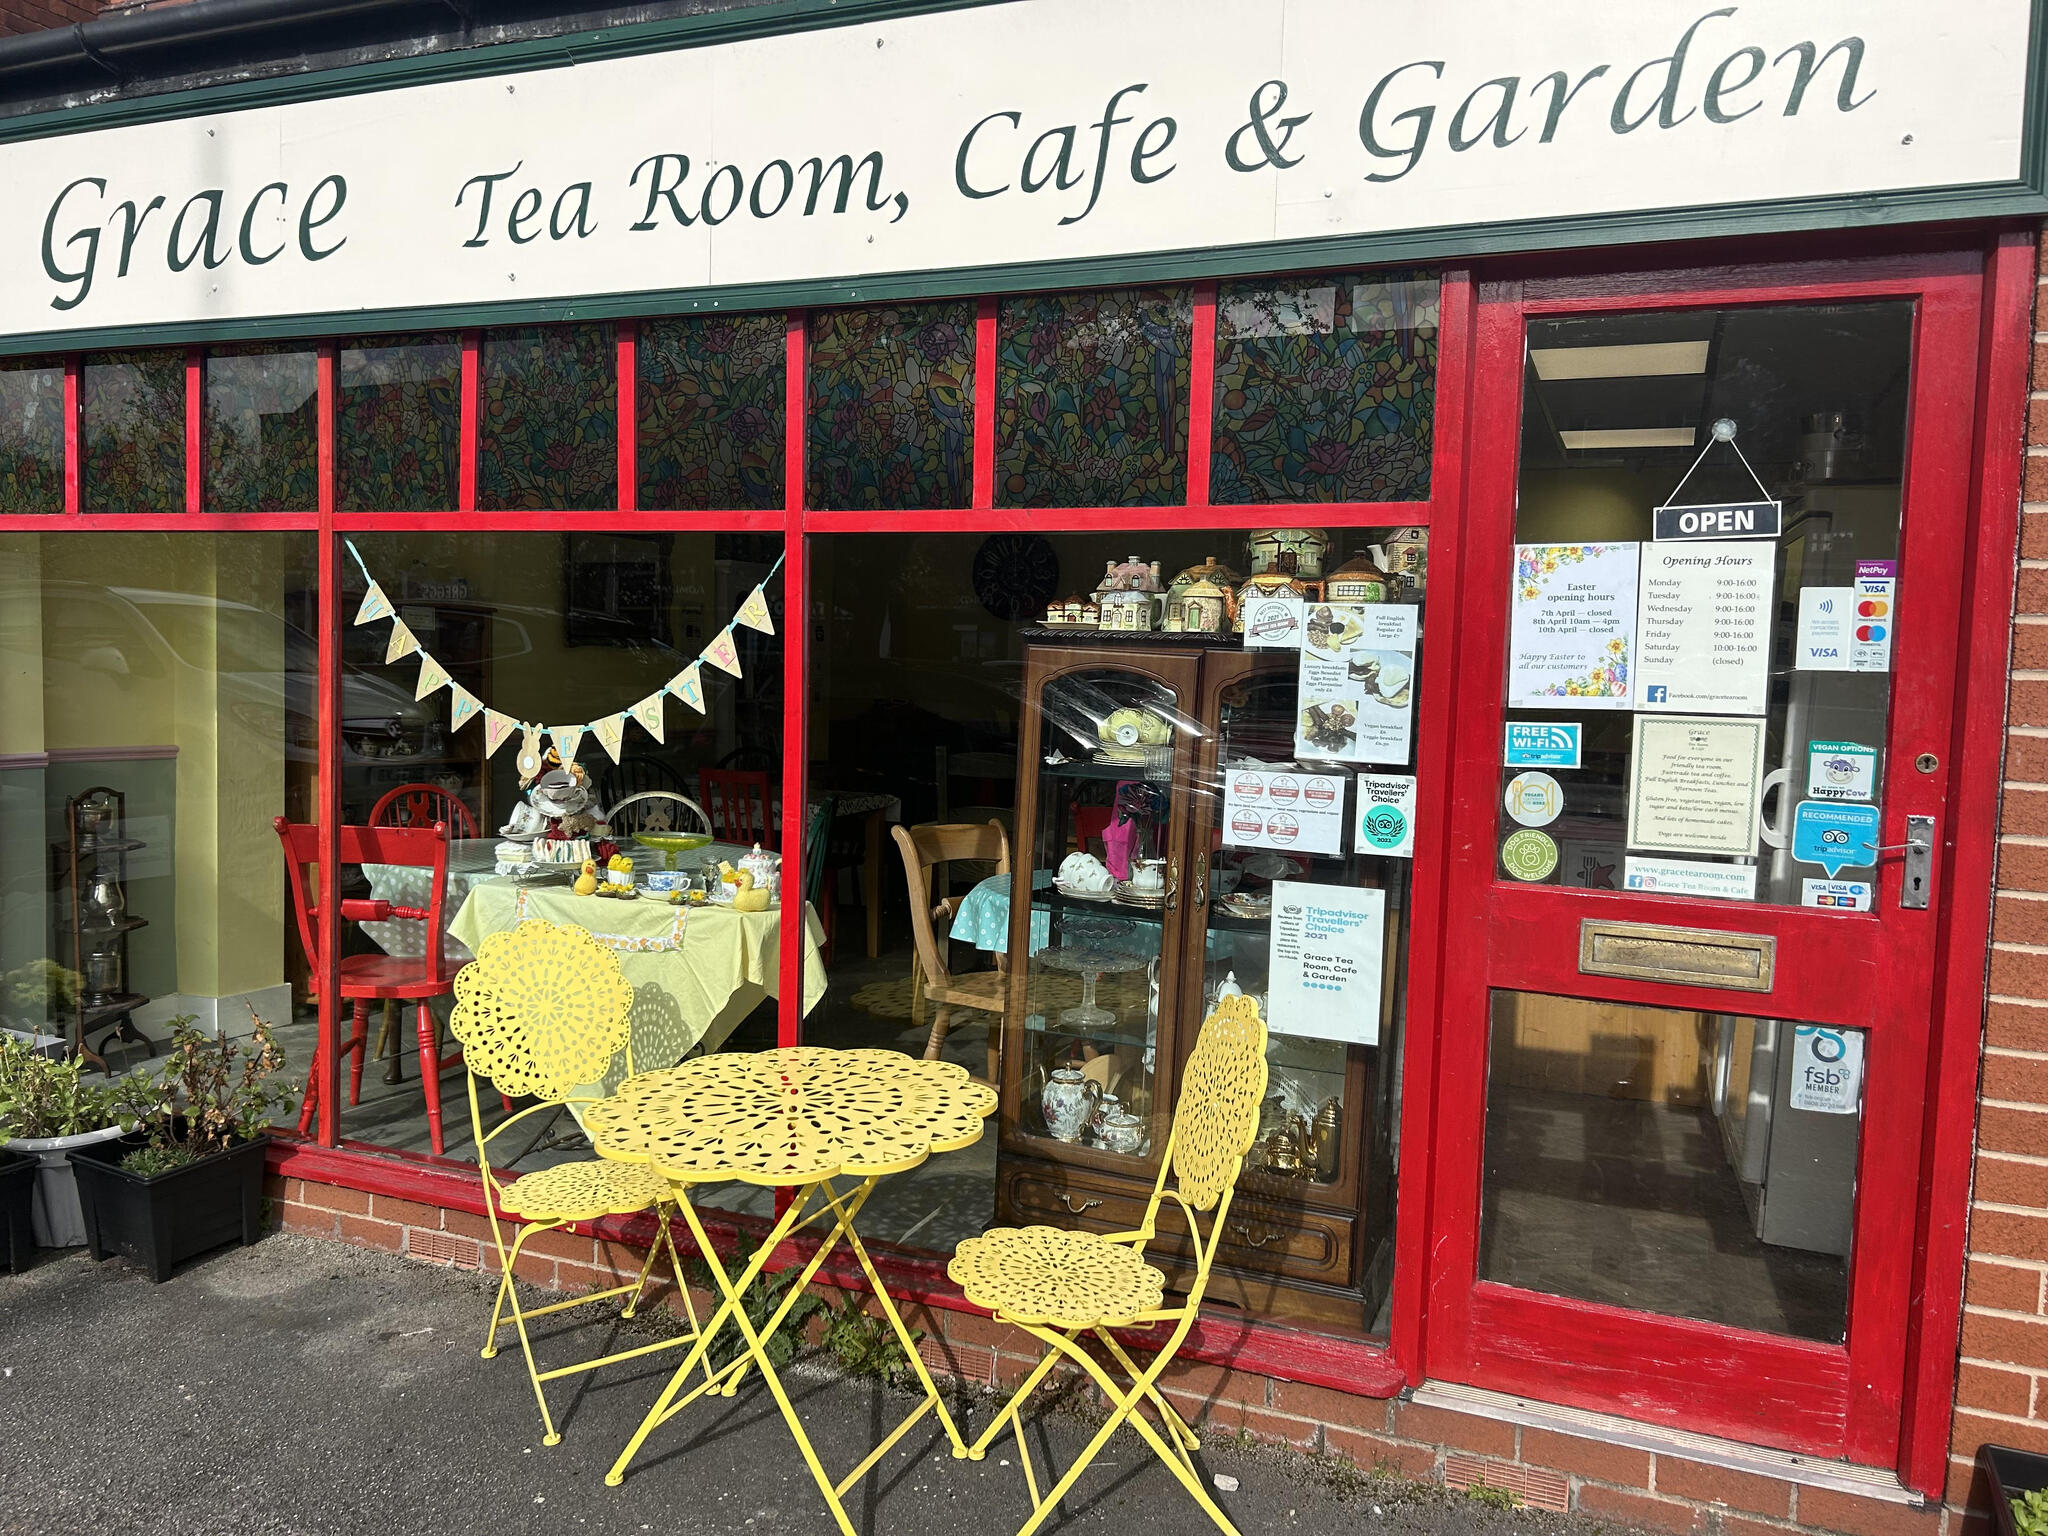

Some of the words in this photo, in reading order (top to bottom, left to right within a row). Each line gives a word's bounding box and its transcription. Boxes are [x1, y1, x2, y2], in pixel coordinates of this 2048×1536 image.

[40, 173, 348, 311] Grace
[454, 159, 598, 248] Tea
[629, 150, 910, 232] Room,
[954, 82, 1178, 226] Cafe
[1224, 79, 1313, 173] &
[1357, 6, 1878, 183] Garden
[1679, 509, 1754, 534] OPEN
[1662, 555, 1712, 569] Opening
[1714, 555, 1753, 566] Hours
[1858, 566, 1889, 576] NetPay
[1567, 583, 1597, 591] Easter
[1648, 579, 1682, 589] Monday
[1716, 579, 1757, 587] 9:00-16:00
[1863, 585, 1887, 593] VISA
[1547, 592, 1585, 602] opening
[1587, 592, 1615, 601] hours
[1647, 592, 1681, 601] Tuesday
[1715, 592, 1756, 600] 9:00-16:00
[1541, 609, 1554, 617] 7th
[1556, 609, 1576, 618] April
[1587, 609, 1612, 617] closed
[1646, 604, 1693, 614] Wednesday
[1714, 605, 1756, 613] 9:00-16:00
[1548, 618, 1567, 626] April
[1602, 618, 1620, 626] 4pm
[1645, 617, 1684, 627] Thursday
[1713, 618, 1755, 626] 9:00-16:00
[1538, 626, 1556, 634] 10th
[1557, 626, 1577, 635] April
[1588, 626, 1614, 634] closed
[1645, 630, 1671, 640] Friday
[1713, 631, 1754, 639] 9:00-16:00
[1644, 643, 1681, 652] Saturday
[1712, 644, 1758, 653] 10:00-16:00
[1808, 647, 1839, 658] VISA
[1518, 653, 1547, 663] Happy
[1549, 652, 1576, 661] Easter
[1643, 656, 1674, 666] Sunday
[1712, 657, 1744, 666] (closed)
[360, 593, 507, 743] HAPPY
[1518, 662, 1530, 670] all
[559, 600, 767, 759] EASTER
[1513, 726, 1549, 737] FREE
[1688, 728, 1711, 736] Grace
[1512, 737, 1549, 748] WI-FI
[1812, 743, 1839, 752] VEGAN
[1840, 744, 1874, 754] OPTIONS
[1364, 780, 1411, 791] Tripadvisor
[1365, 787, 1408, 798] Travellers'
[1812, 786, 1868, 798] HappyCow
[1371, 794, 1400, 805] Choice
[1801, 811, 1874, 824] RECOMMENDED
[1506, 836, 1520, 851] DOG
[1519, 832, 1553, 848] FRIENDLY
[1814, 845, 1857, 856] tripadvisor
[1508, 862, 1523, 876] DOG
[1523, 860, 1555, 879] WELCOME
[1634, 865, 1746, 882] www.gracetearoom.com
[1657, 880, 1681, 889] Grace
[1682, 882, 1696, 890] Tea
[1697, 884, 1721, 892] Room
[1722, 885, 1730, 893] &
[1730, 886, 1749, 895] Cafe
[1810, 883, 1827, 892] VISA
[1830, 884, 1848, 892] VISA
[1305, 906, 1369, 921] Tripadvisor
[1305, 914, 1363, 928] Travellers'
[1305, 922, 1345, 934] Choice
[1303, 931, 1328, 941] 2021
[1303, 952, 1333, 963] Grace
[1334, 956, 1354, 966] Tea
[1302, 961, 1332, 973] Room,
[1333, 965, 1358, 975] Cafe
[1311, 971, 1348, 983] Garden
[1804, 1066, 1841, 1086] fsb
[1805, 1082, 1840, 1095] MEMBER
